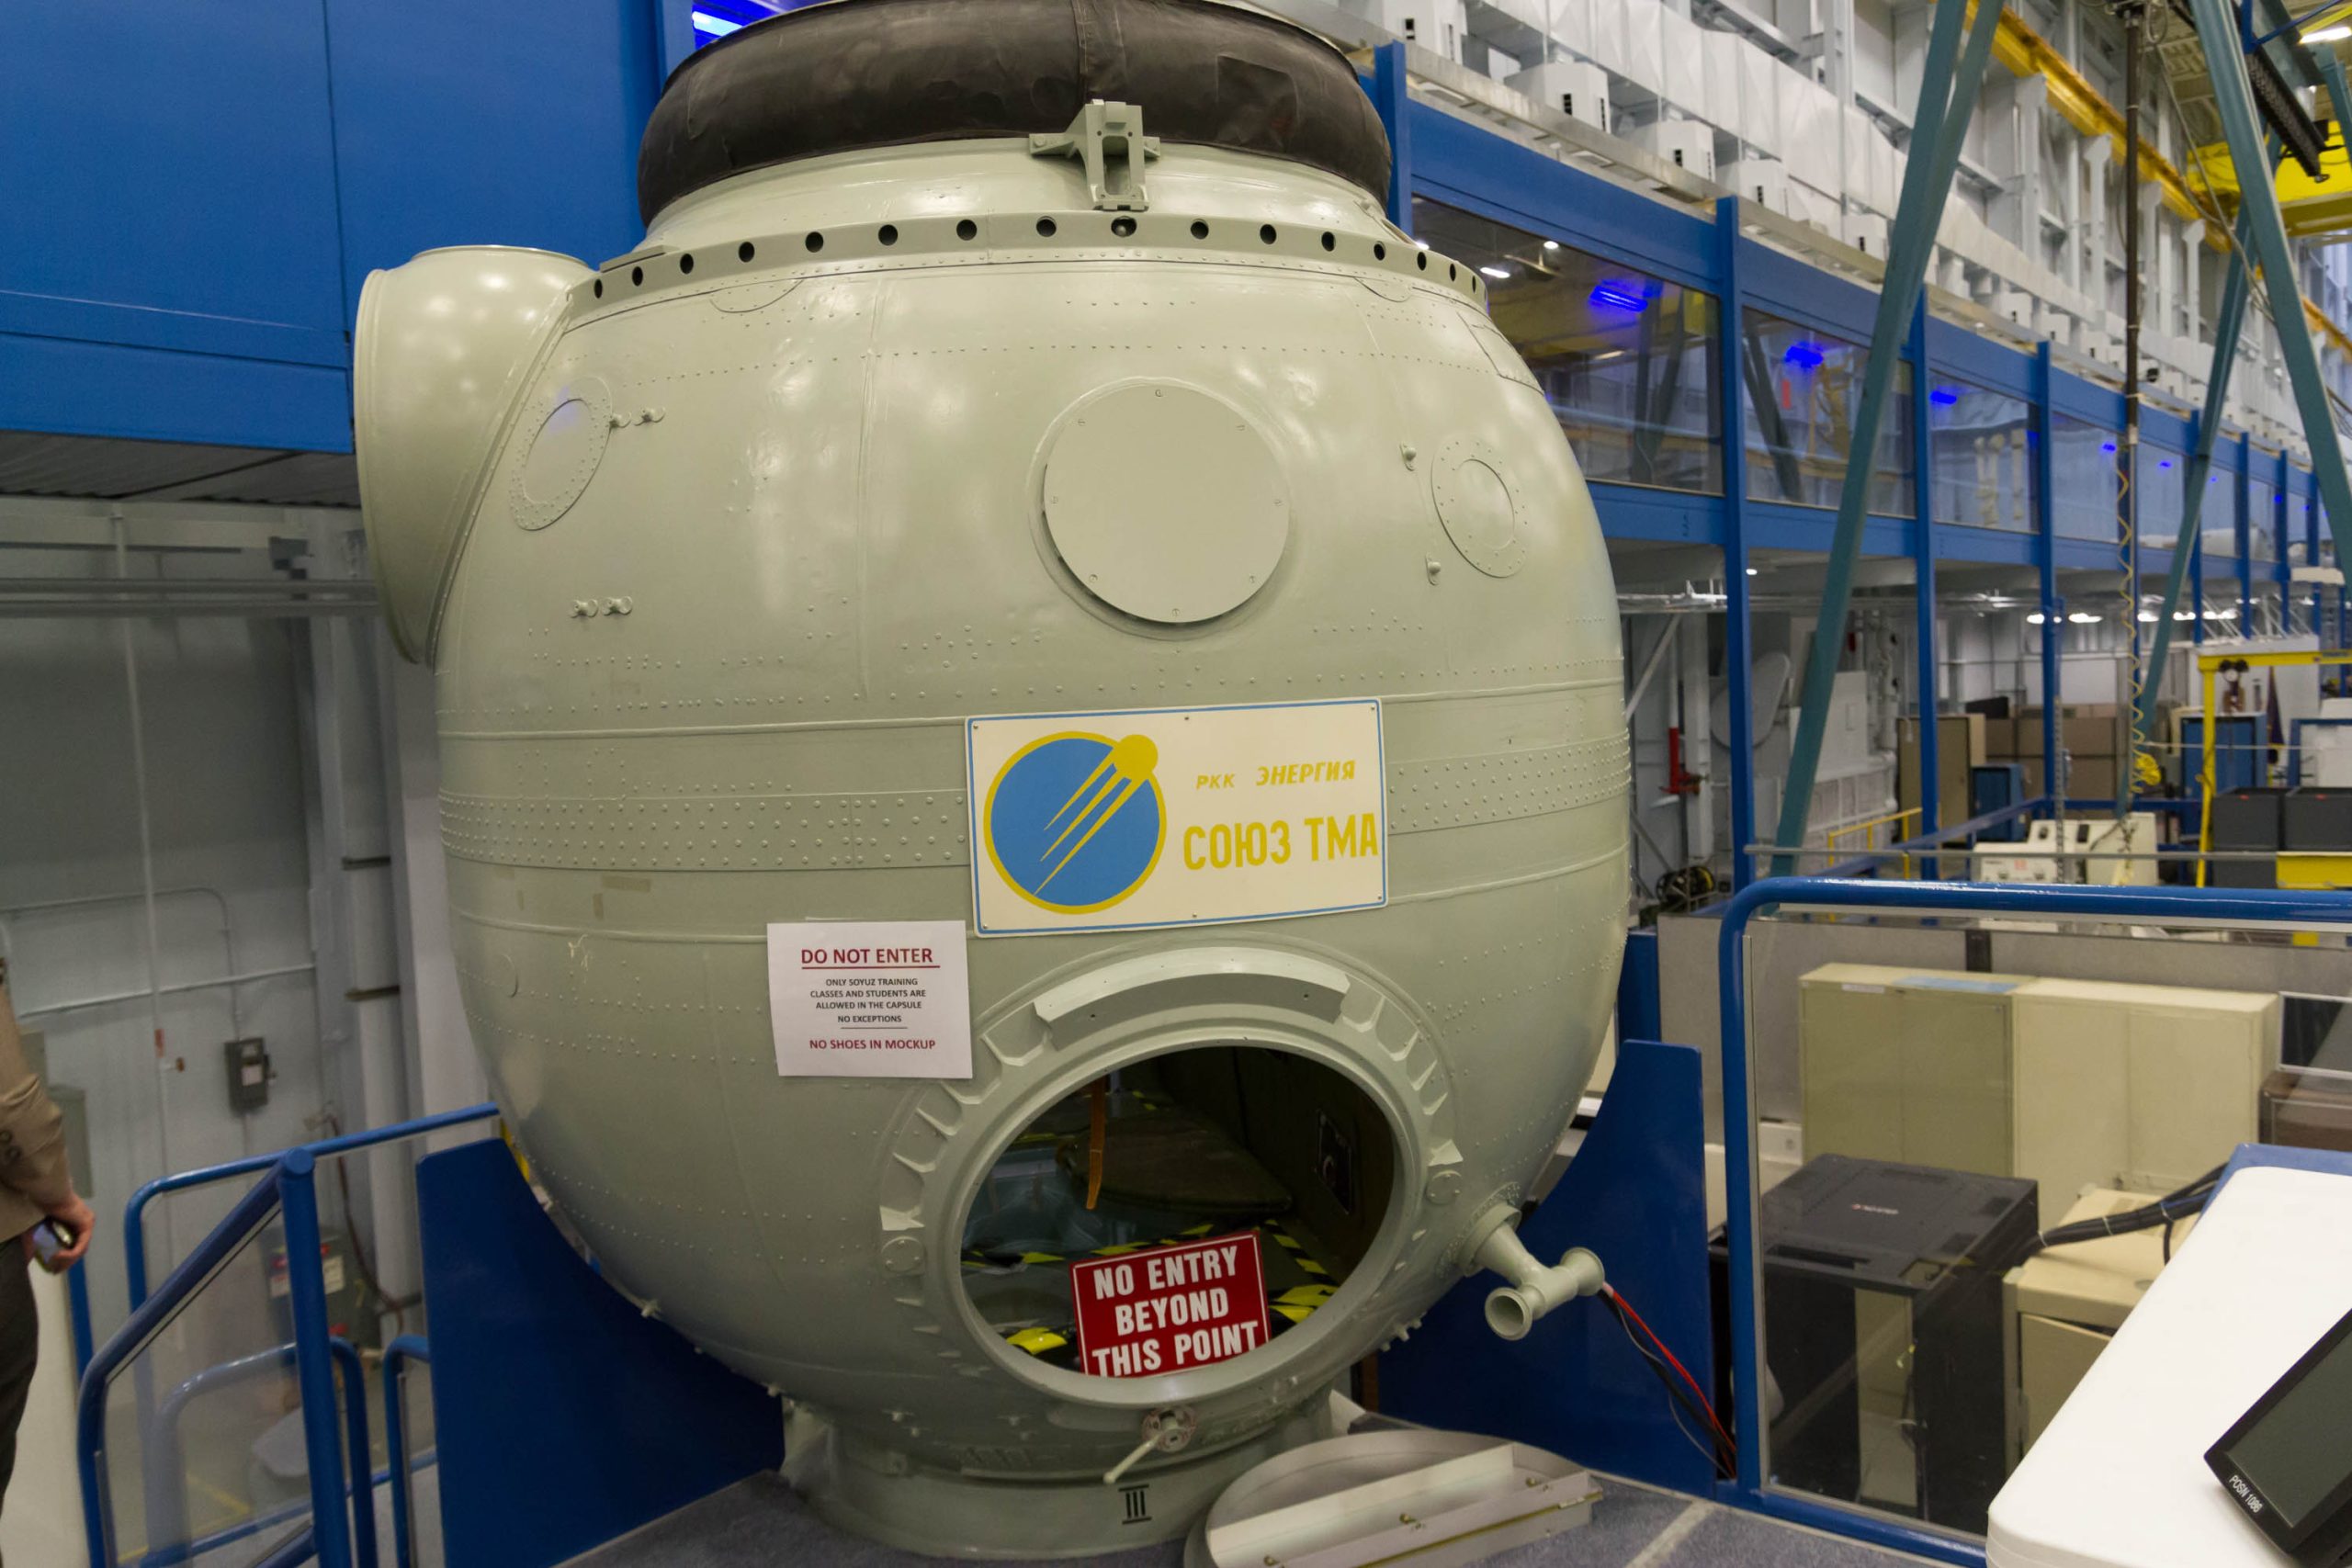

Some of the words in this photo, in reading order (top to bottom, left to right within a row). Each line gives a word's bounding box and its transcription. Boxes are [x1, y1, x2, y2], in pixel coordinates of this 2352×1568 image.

[1195, 772, 1236, 790] РКК
[1255, 760, 1356, 787] ЭНЕРГИЯ
[1182, 819, 1292, 871] СОЮЗ
[1305, 812, 1379, 863] ТМА
[801, 949, 828, 964] DO
[833, 948, 871, 964] NOT
[876, 948, 933, 964] ENTER
[825, 978, 846, 987] ONLY
[877, 977, 918, 986] TRAINING
[865, 989, 908, 998] STUDENTS
[910, 989, 926, 998] ARE
[815, 1001, 855, 1010] ALLOWED
[837, 1015, 851, 1023] NO
[809, 1040, 827, 1049] NO
[830, 1040, 866, 1049] SHOES
[869, 1040, 882, 1049] IN
[885, 1039, 936, 1050] MOCKUP
[1092, 1263, 1136, 1300] NO
[1147, 1245, 1238, 1291] ENTRY
[1114, 1287, 1229, 1337] BEYOND
[1091, 1338, 1162, 1378] THIS
[1173, 1320, 1259, 1365] POINT
[2229, 1474, 2250, 1498] POSN
